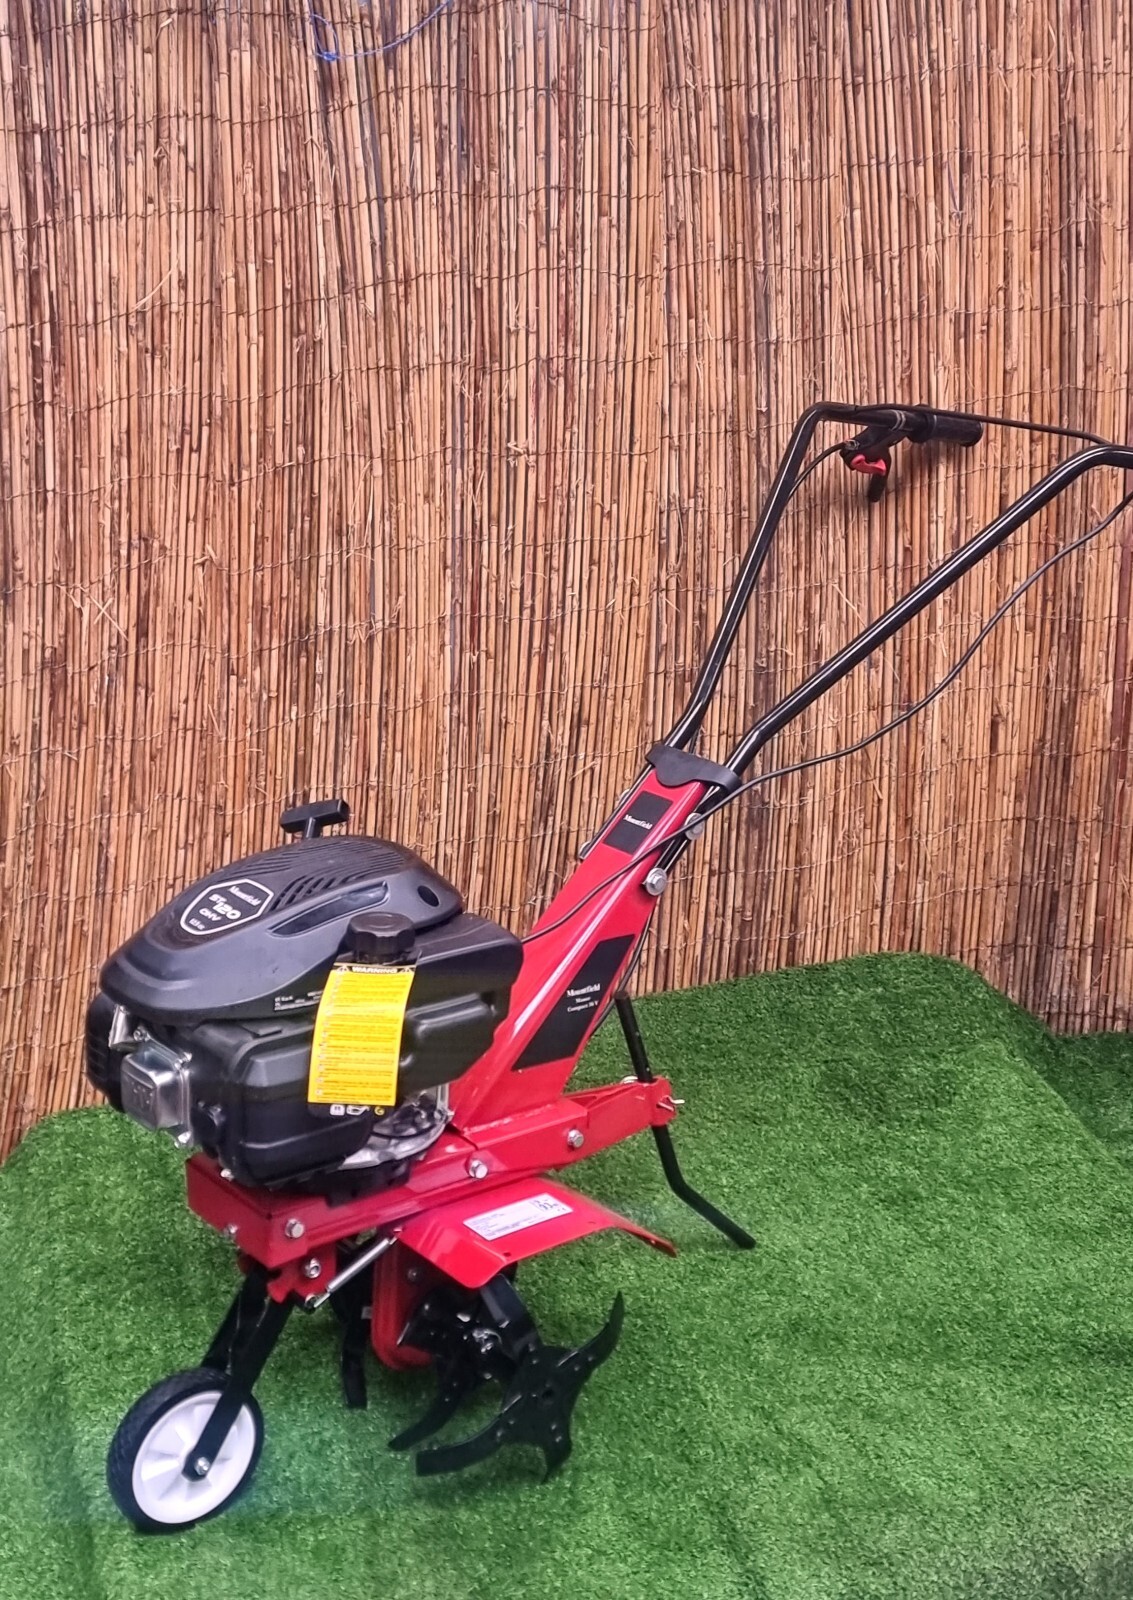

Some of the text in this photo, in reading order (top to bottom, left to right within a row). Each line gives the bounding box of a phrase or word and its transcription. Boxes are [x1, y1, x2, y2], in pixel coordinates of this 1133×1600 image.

[623, 814, 653, 830] Mountfield
[209, 894, 227, 903] ST
[228, 886, 261, 906] Mountfield
[199, 908, 222, 921] OHV
[213, 902, 241, 919] 120
[567, 983, 600, 996] Mountfield
